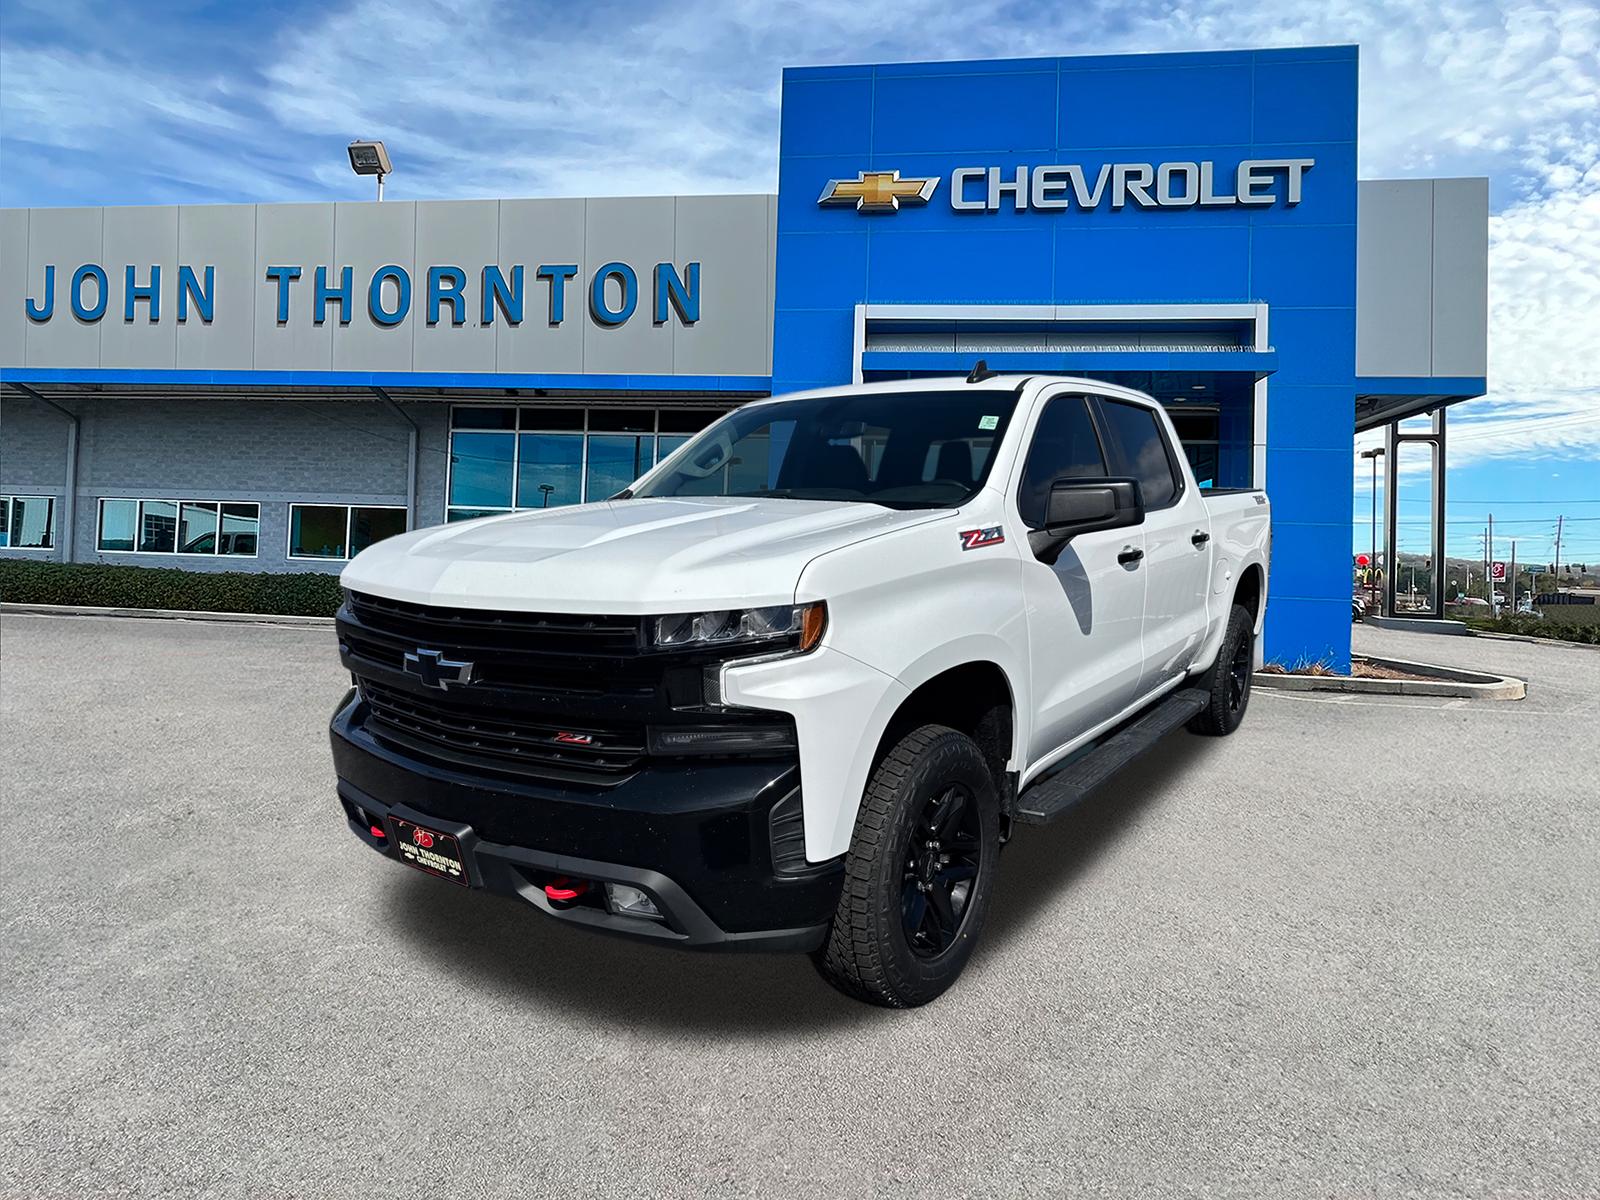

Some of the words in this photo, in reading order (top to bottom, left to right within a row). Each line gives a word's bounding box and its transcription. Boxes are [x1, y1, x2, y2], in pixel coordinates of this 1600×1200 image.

[951, 158, 1315, 213] CHEVROLET
[25, 263, 216, 324] JOHN
[266, 261, 702, 329] THORNTON
[400, 841, 419, 855] JOHN
[420, 848, 461, 871] THORNTON
[416, 855, 447, 872] CHEVROLET
